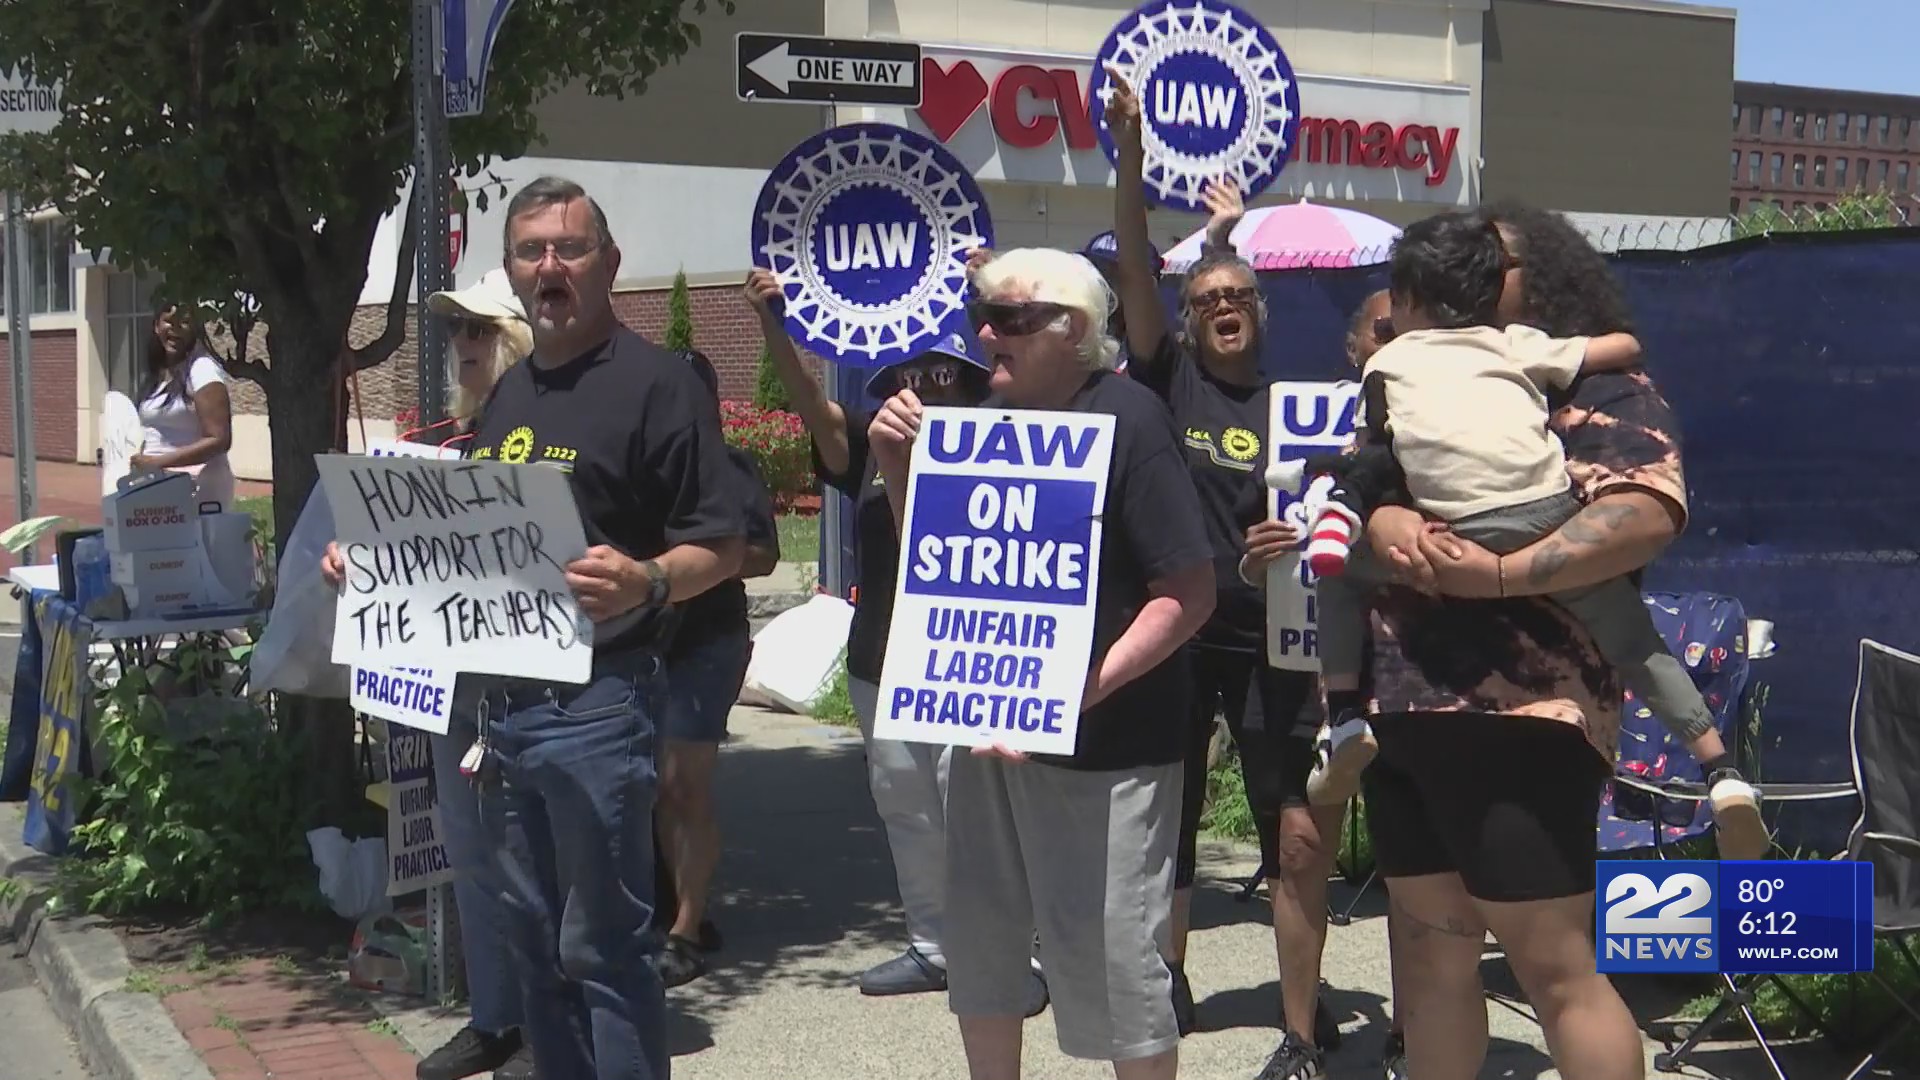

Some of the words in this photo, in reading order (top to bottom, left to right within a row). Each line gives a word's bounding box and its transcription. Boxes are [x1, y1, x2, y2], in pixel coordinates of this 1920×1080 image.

[797, 59, 844, 81] ONE
[852, 61, 902, 84] WAY
[990, 65, 1098, 148] CV
[1289, 116, 1460, 186] rmacy
[1155, 80, 1237, 130] UAW
[824, 221, 917, 272] UAW
[544, 446, 577, 461] 2322
[929, 419, 1100, 468] UAW
[126, 517, 149, 528] BOX
[967, 482, 1037, 533] ON
[347, 532, 487, 594] SUPPORT
[491, 521, 566, 576] FOR
[913, 534, 1084, 591] STRIKE
[350, 600, 416, 650] THE
[927, 607, 1058, 650] UNFAIR
[356, 668, 446, 717] PRACTICE
[925, 649, 1043, 690] LABOR
[891, 687, 1066, 735] PRACTICE
